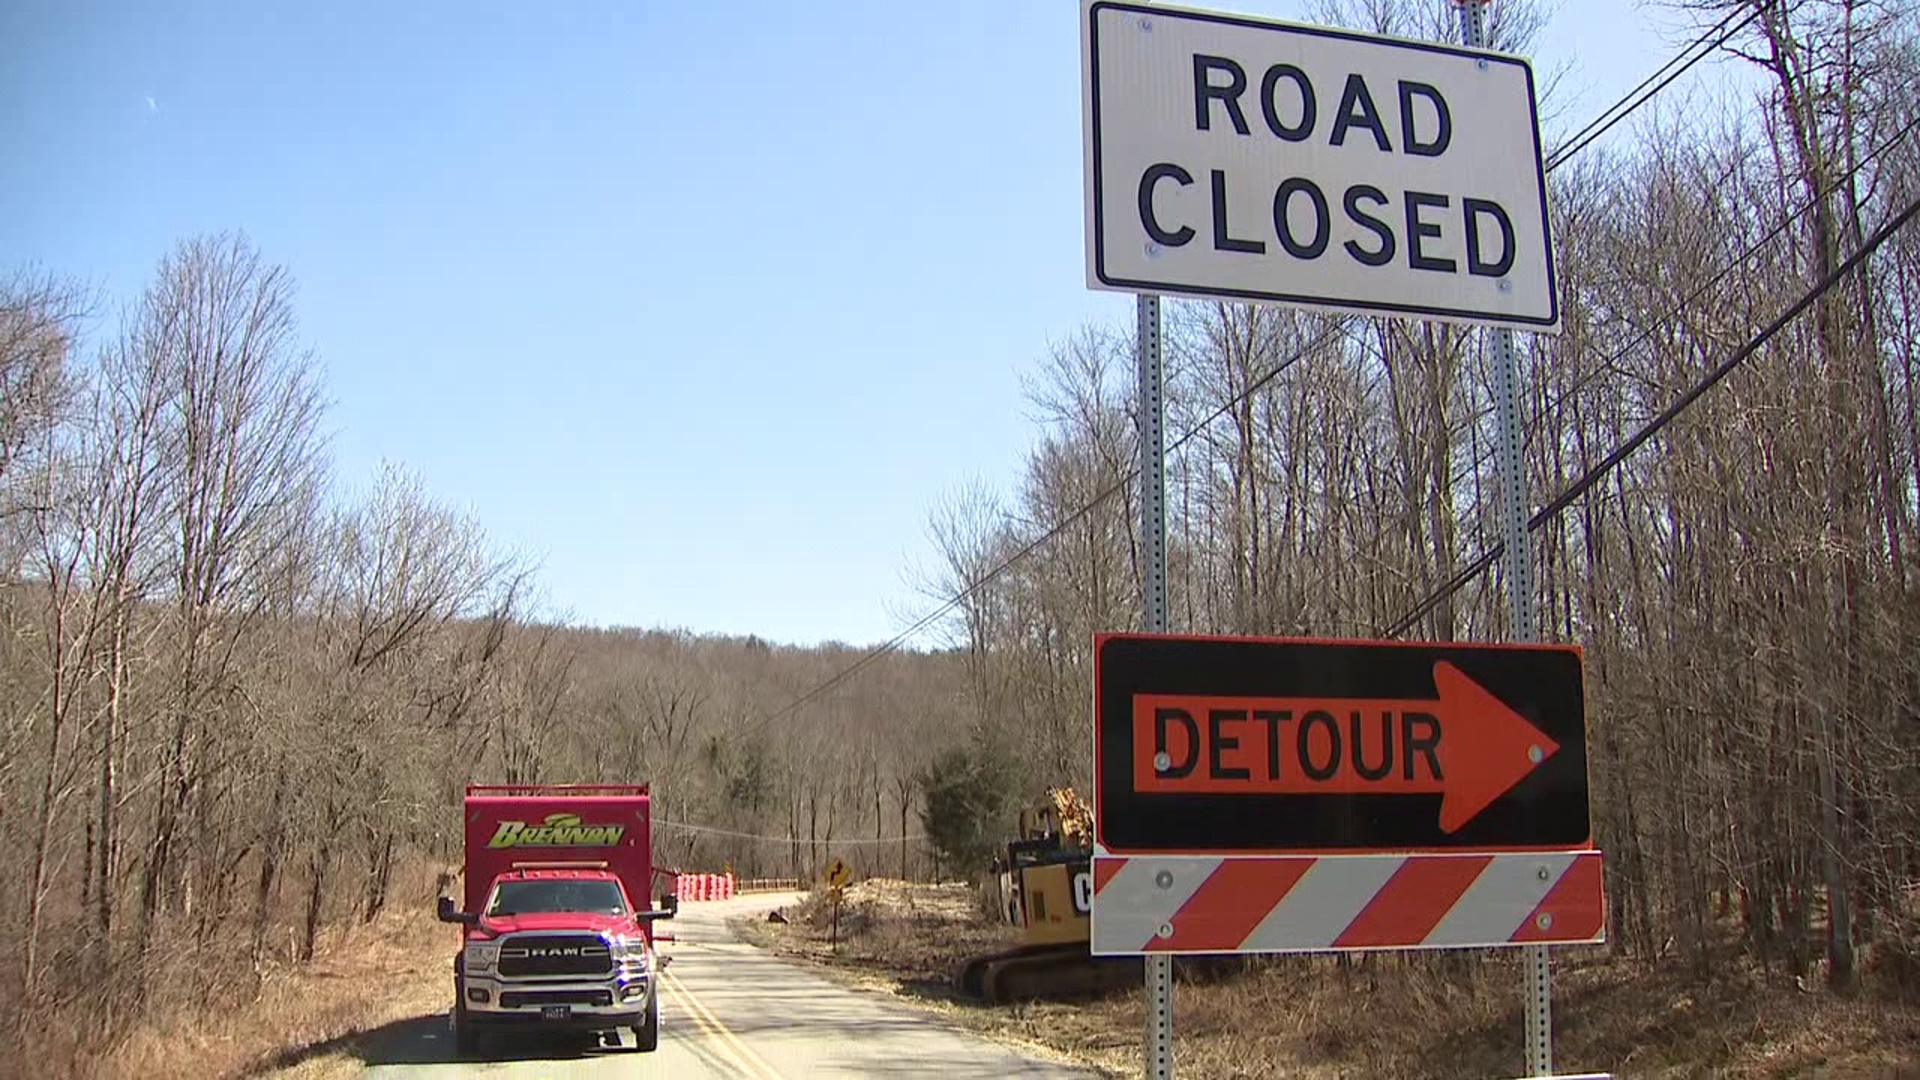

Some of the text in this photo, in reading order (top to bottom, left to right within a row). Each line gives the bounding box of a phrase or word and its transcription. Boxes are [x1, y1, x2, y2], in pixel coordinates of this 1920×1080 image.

[1192, 53, 1452, 158] ROAD
[1137, 163, 1516, 278] CLOSED
[1154, 707, 1445, 782] DETOUR
[486, 820, 625, 848] BRENNAN
[531, 946, 579, 957] RAM
